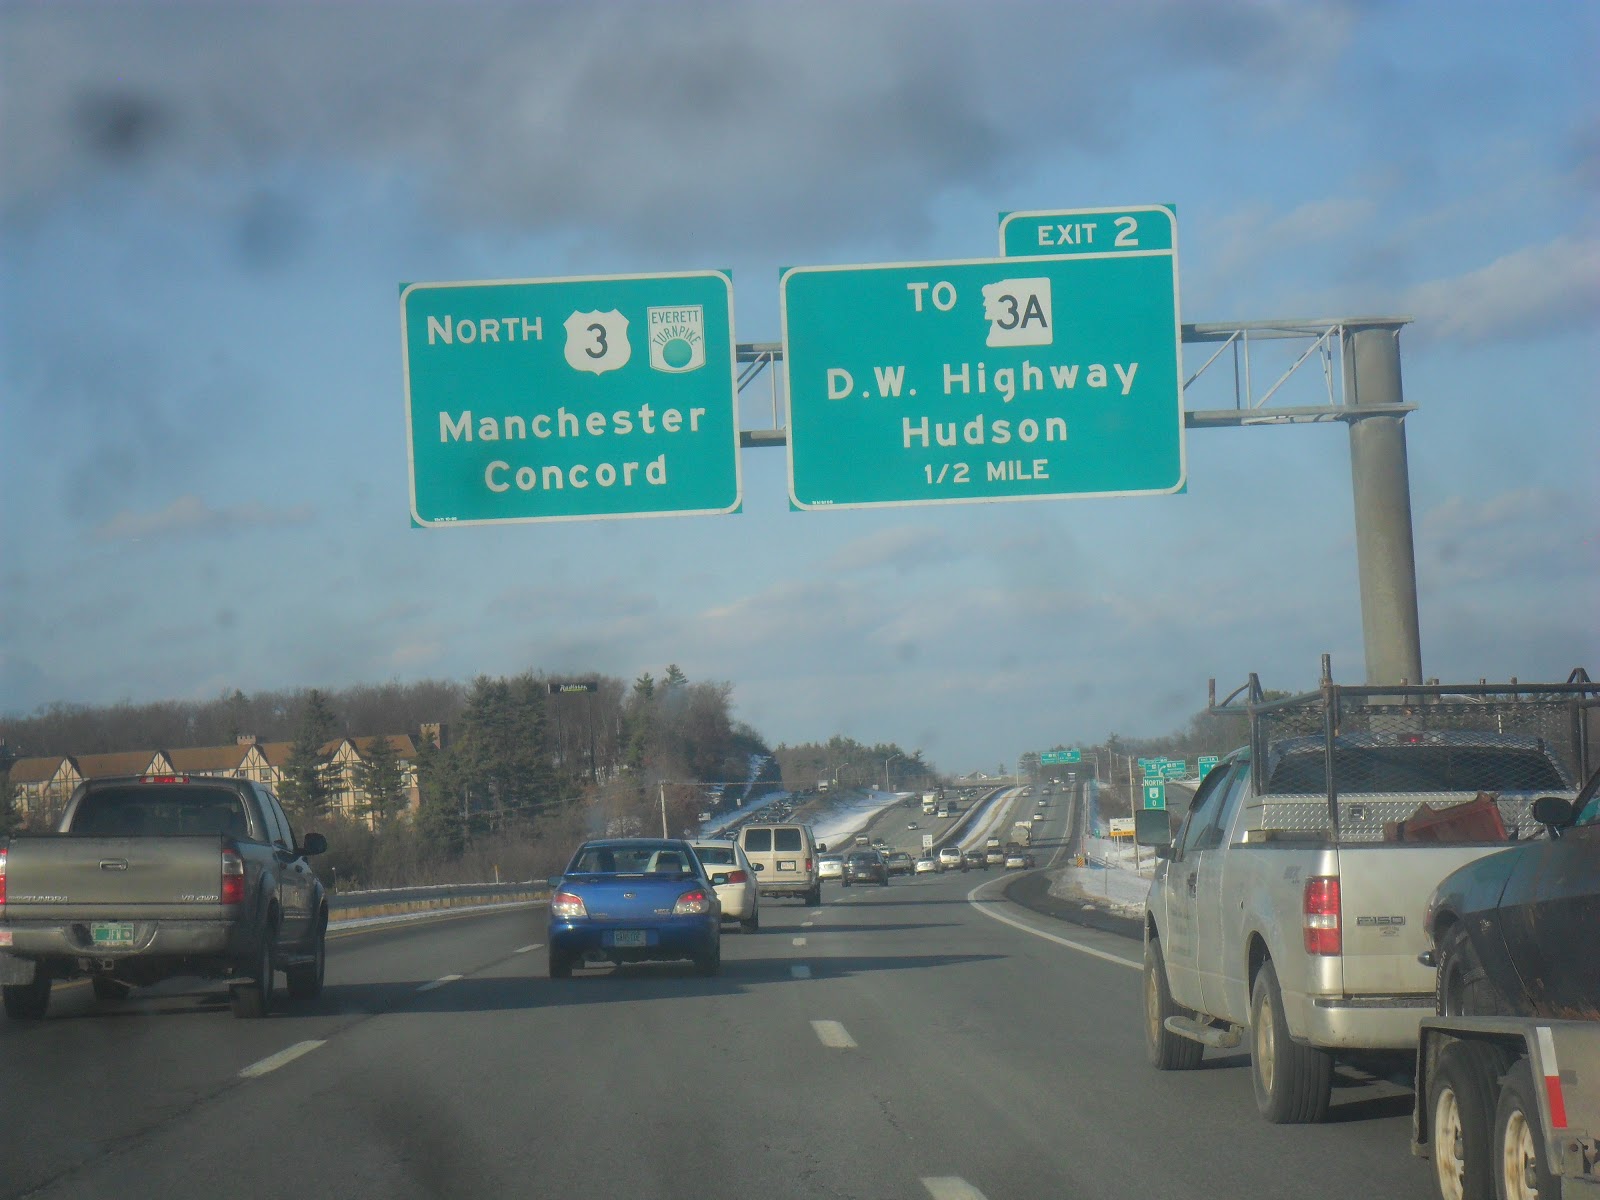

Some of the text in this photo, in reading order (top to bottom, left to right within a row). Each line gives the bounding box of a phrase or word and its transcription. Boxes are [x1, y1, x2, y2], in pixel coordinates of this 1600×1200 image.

[1037, 216, 1139, 247] EXIT 2
[651, 310, 699, 324] EVERETT
[906, 280, 1048, 330] TO 3A
[427, 315, 608, 359] NORTH 3
[652, 325, 702, 347] TURNPIKE
[826, 360, 1139, 403] D.W. Highway
[439, 403, 706, 443] Manchester
[902, 413, 1068, 448] Hudson
[484, 454, 668, 493] Concord
[924, 458, 1050, 484] 1/2 MILE
[1144, 779, 1164, 787] NORTH
